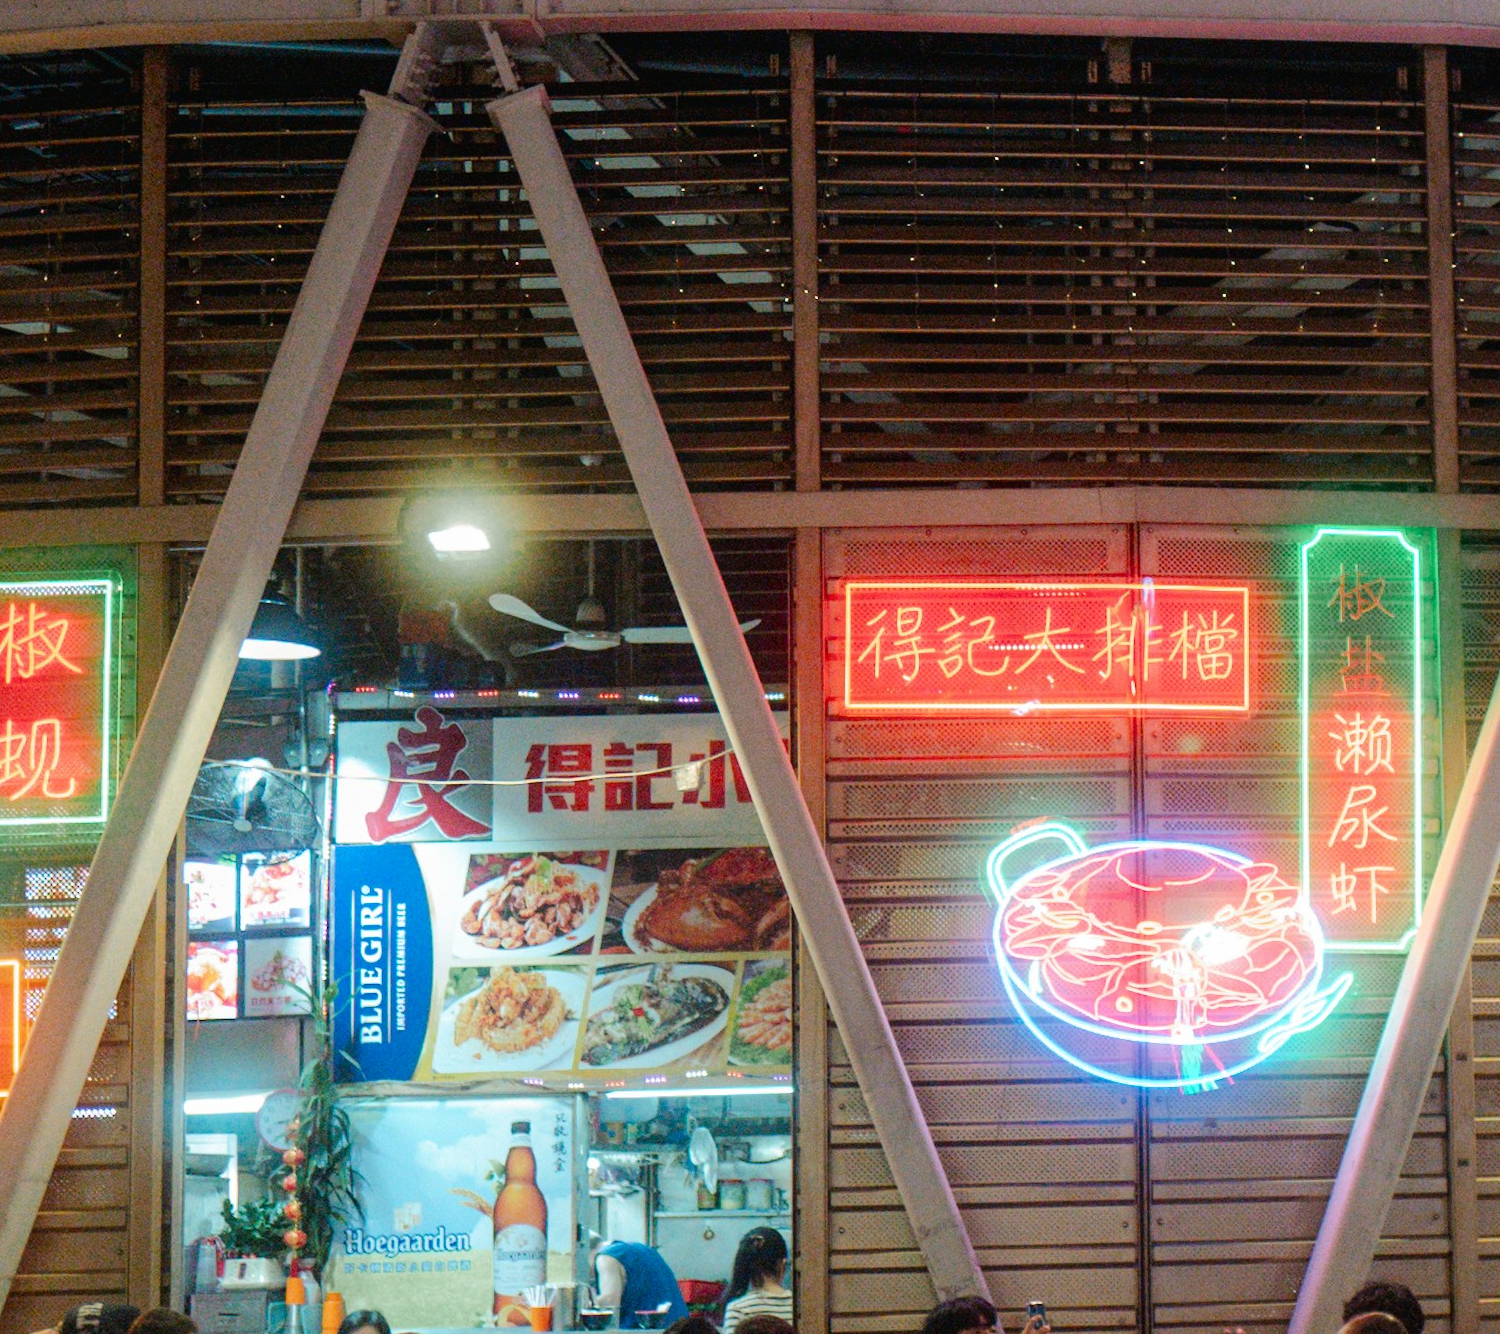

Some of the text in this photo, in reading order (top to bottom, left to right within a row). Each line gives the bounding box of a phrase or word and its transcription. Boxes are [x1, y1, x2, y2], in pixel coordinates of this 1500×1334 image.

[857, 606, 1239, 682] 得記大排檔
[524, 737, 790, 814] 得記小
[1327, 563, 1398, 924] 椒盐濑尿虾
[359, 887, 383, 1044] BLUE GIRL
[396, 902, 407, 1031] IMPORTED PREMIUM BEER
[344, 1225, 472, 1258] Hoegaarden
